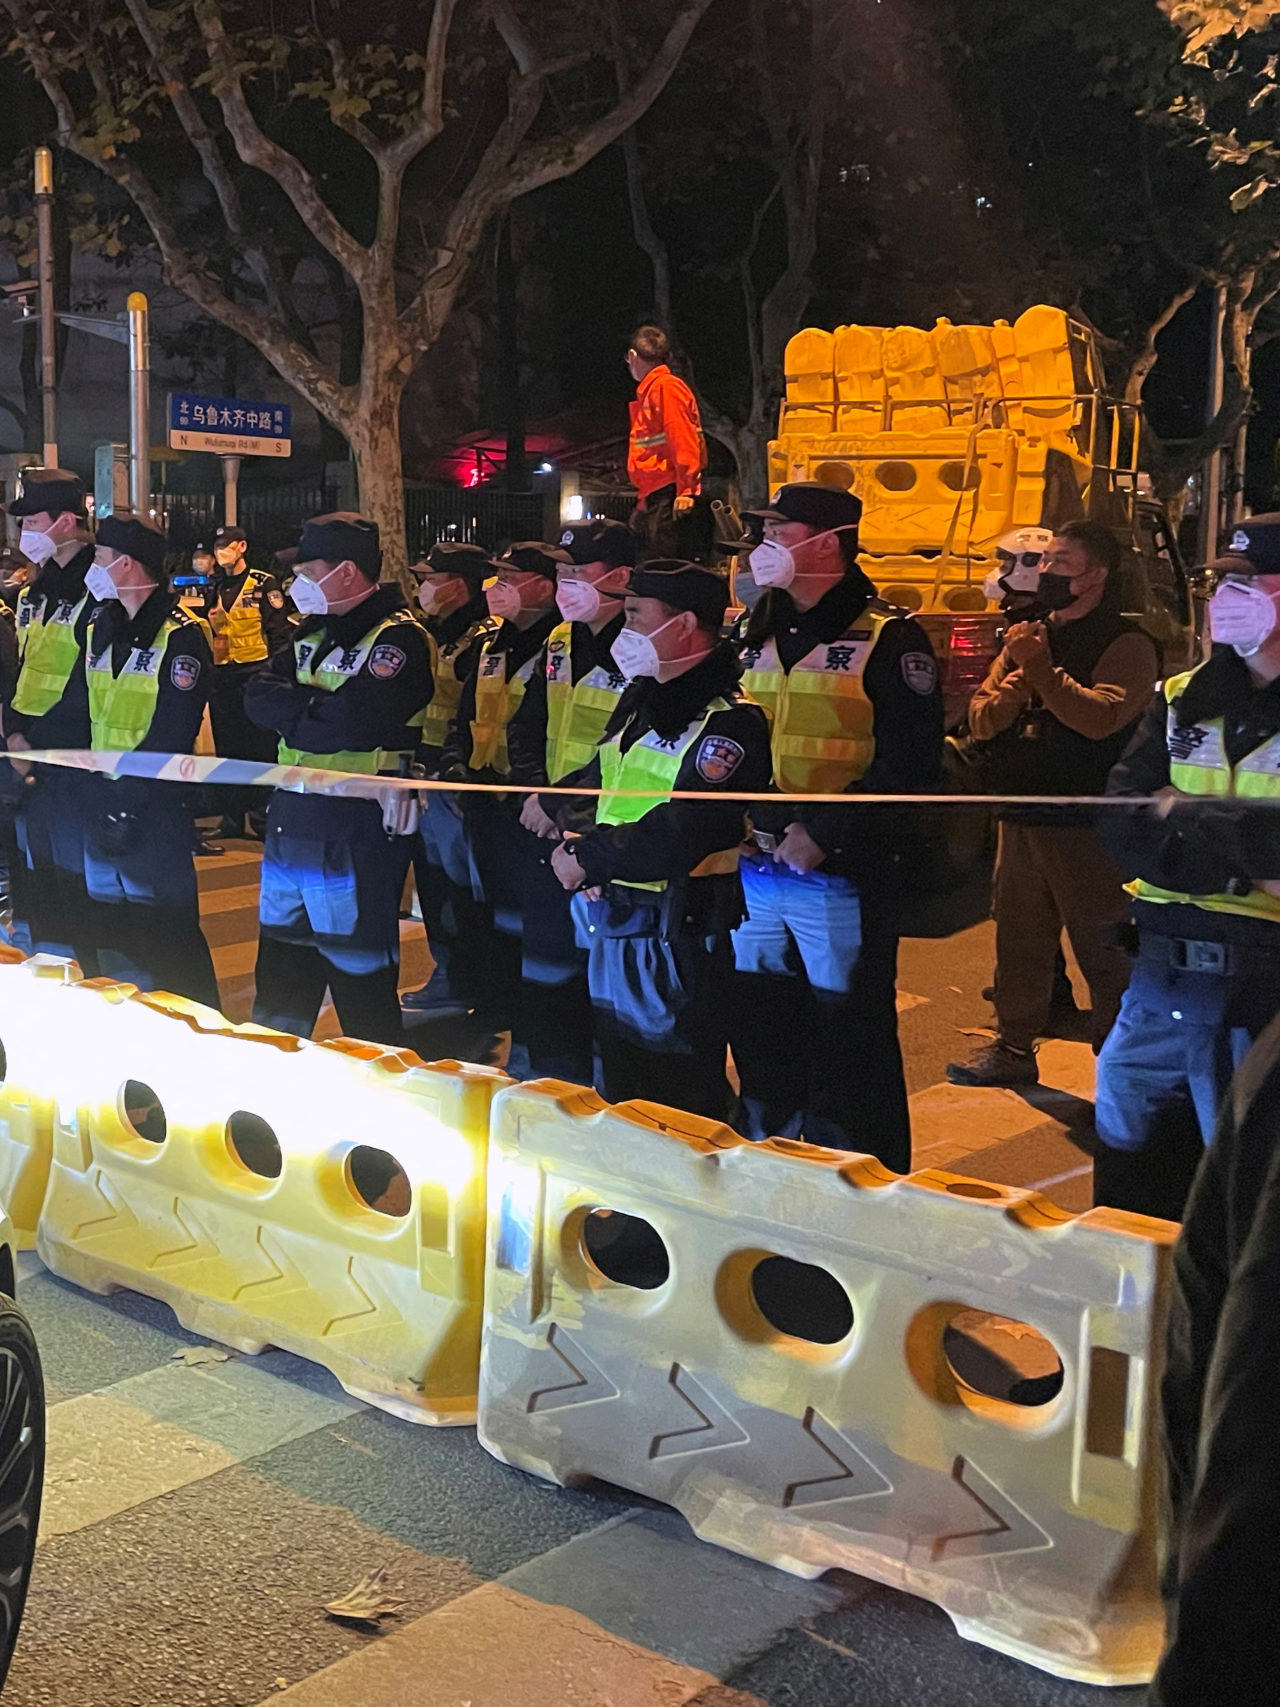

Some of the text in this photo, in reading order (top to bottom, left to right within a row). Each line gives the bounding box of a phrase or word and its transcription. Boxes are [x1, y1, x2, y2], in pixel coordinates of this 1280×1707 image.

[192, 403, 271, 430] 乌鲁木齐中路
[180, 435, 188, 446] N
[275, 442, 282, 453] S
[824, 644, 857, 672] 察
